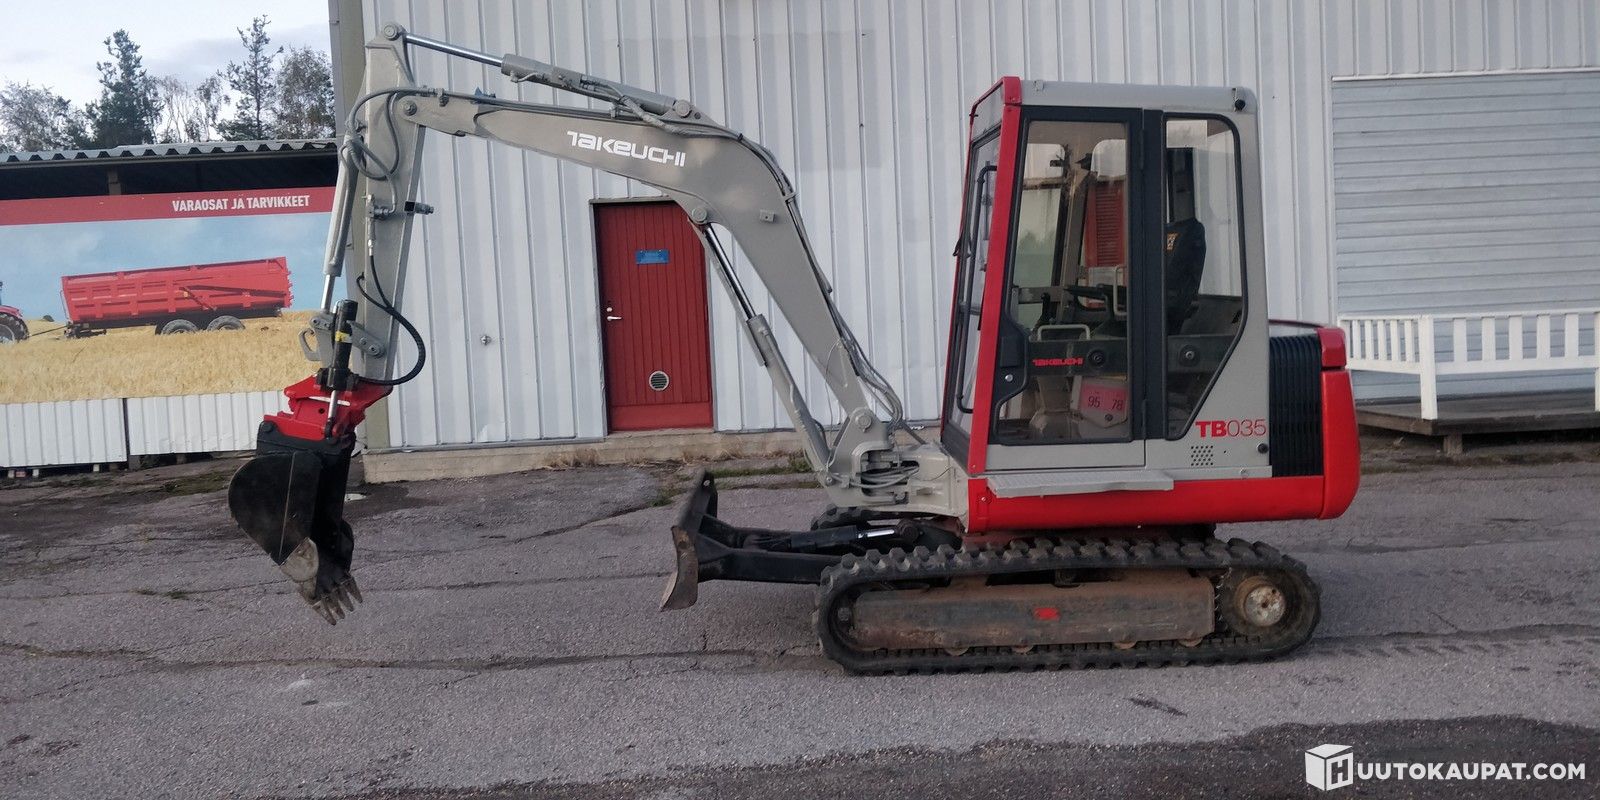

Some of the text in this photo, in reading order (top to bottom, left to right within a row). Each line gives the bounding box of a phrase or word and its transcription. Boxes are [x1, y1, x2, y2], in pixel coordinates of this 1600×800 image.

[567, 130, 686, 167] TAKEUCHI
[172, 198, 229, 212] VARAOSAT
[246, 195, 310, 209] TARVIKKEET
[1195, 418, 1267, 438] TB035
